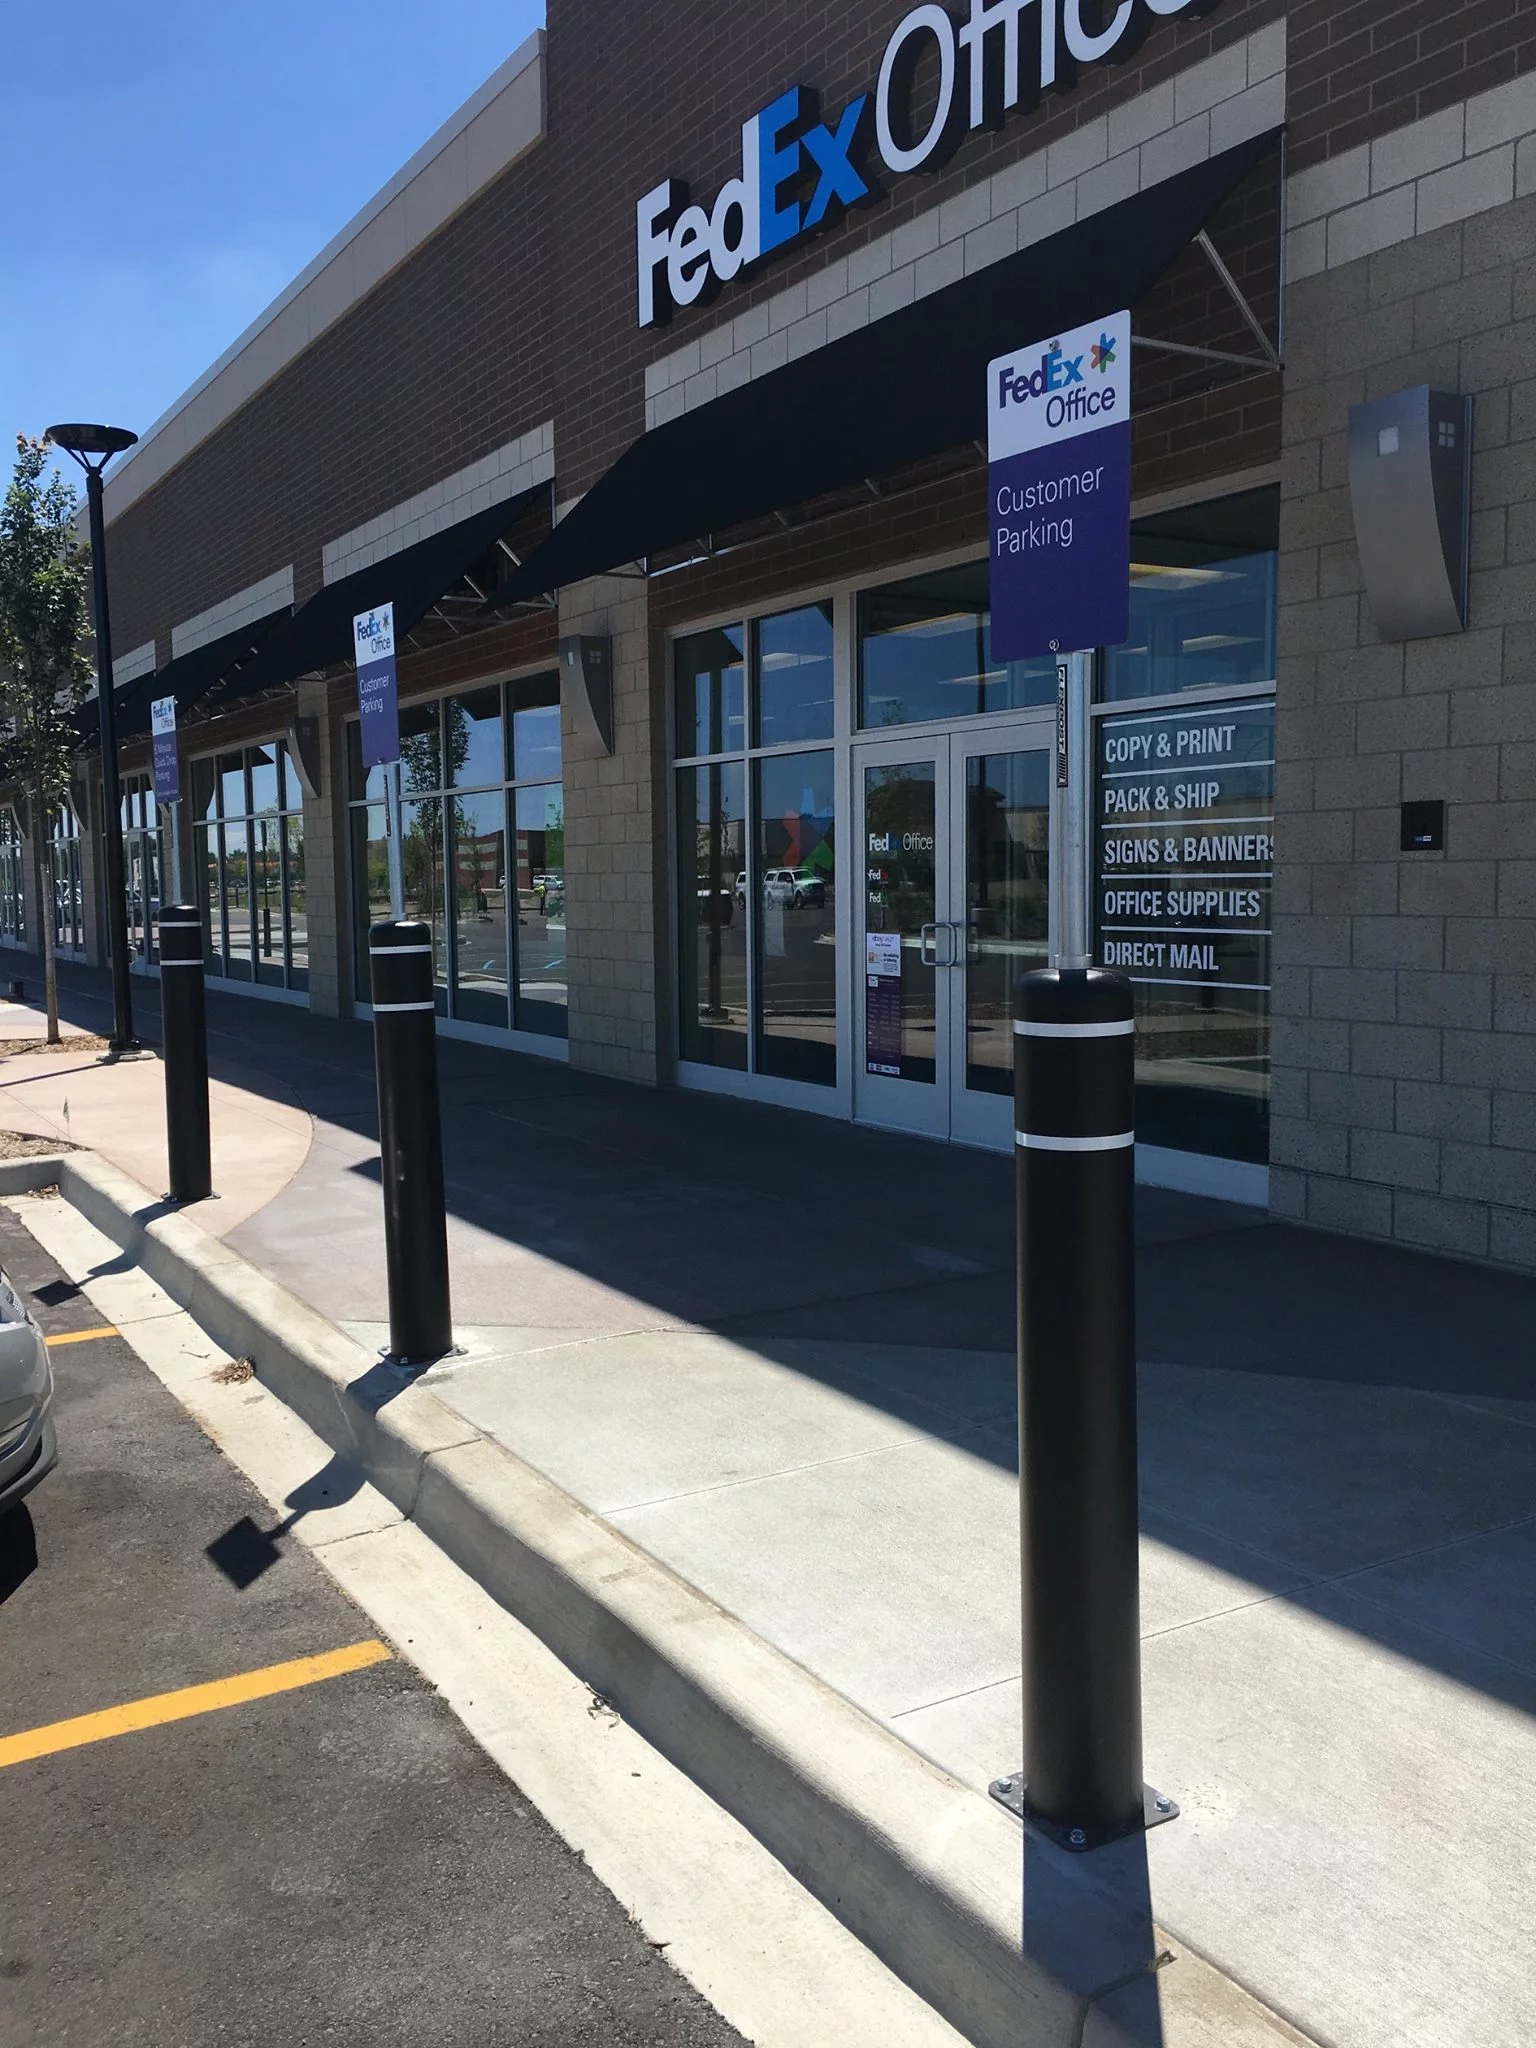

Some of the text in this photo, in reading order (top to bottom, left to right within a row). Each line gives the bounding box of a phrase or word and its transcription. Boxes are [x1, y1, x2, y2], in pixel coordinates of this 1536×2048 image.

[637, 0, 1192, 329] FedEx Offic
[999, 349, 1085, 408] FedEx
[1046, 386, 1116, 428] Office
[996, 466, 1104, 516] Customer
[997, 517, 1073, 557] Parking
[357, 617, 381, 641] FedEx
[371, 636, 391, 654] Office
[359, 674, 390, 694] Customer
[360, 696, 383, 714] Parking
[1105, 725, 1236, 763] COPY & PRINT
[1104, 781, 1220, 814] PACK & SHIP
[869, 832, 933, 852] Fed Office
[1104, 834, 1274, 866] SIGNS & BANNER
[1104, 889, 1260, 917] OFFICE SUPPLIES
[1104, 941, 1219, 971] DIRECT MAIL
